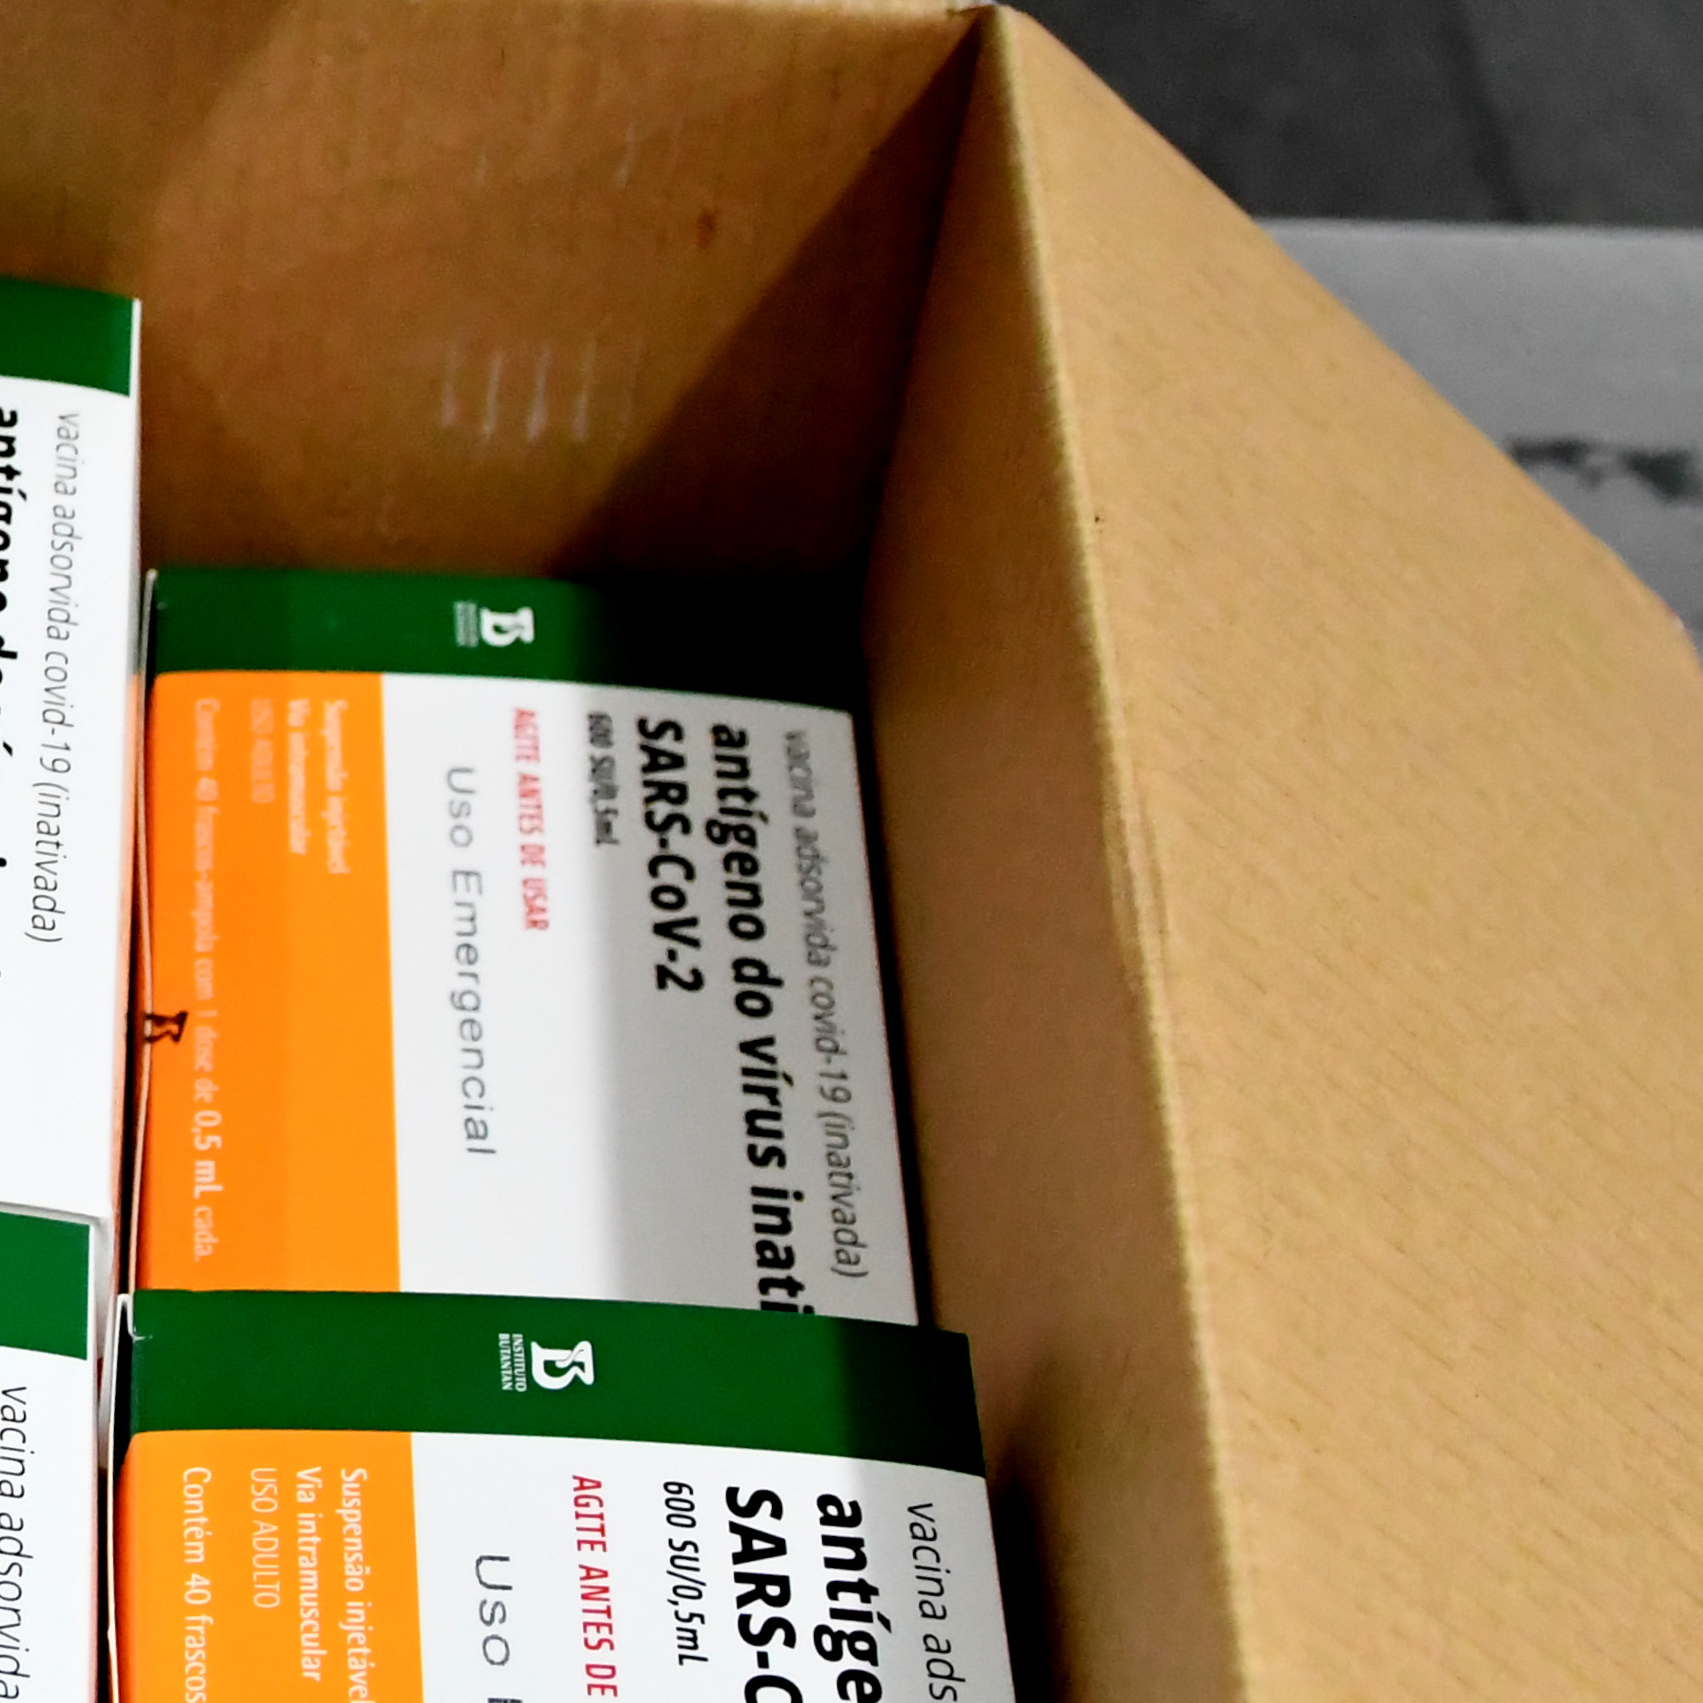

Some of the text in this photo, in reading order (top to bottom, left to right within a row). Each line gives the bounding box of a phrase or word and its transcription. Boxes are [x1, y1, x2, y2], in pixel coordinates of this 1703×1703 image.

[24, 650, 75, 943] covid-19 (inativada)
[633, 716, 706, 993] SARS-CoV-2
[445, 766, 497, 1155] Uso Emergencial
[691, 722, 815, 1313] antígeno do vírus inati
[806, 975, 869, 1279] covid-19 (inativada)
[250, 1467, 282, 1610] USO ADULTO
[295, 1466, 328, 1682] Via intramuscular
[335, 1467, 372, 1593] Suspensão
[475, 1554, 513, 1667] Uso
[572, 1474, 618, 1697] AGITE ANTES DE
[662, 1481, 709, 1666] 600 SU/0,5mL
[812, 1494, 891, 1703] antíge
[906, 1502, 951, 1621] vacina
